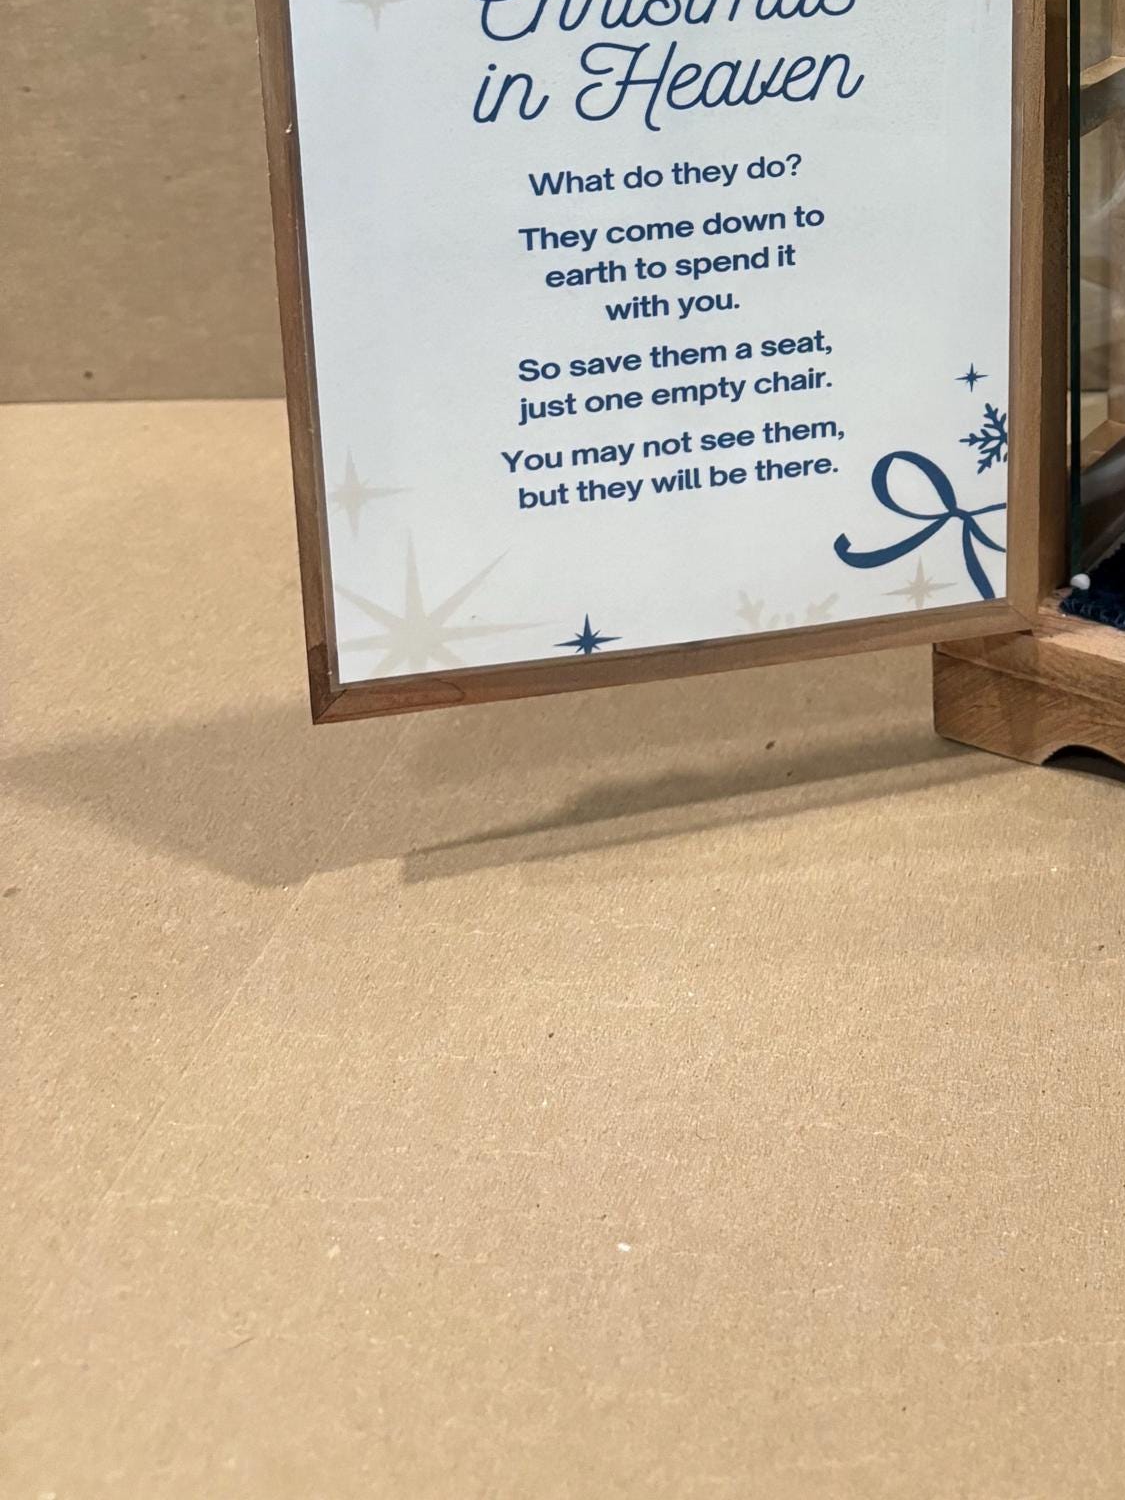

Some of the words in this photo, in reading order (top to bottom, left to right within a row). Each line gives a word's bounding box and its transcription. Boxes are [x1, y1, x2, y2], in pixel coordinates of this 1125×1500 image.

[472, 63, 550, 124] in
[575, 40, 865, 132] Heaven
[528, 167, 616, 197] What
[623, 165, 664, 190] do
[670, 161, 739, 188] they
[746, 153, 802, 180] do?
[517, 226, 599, 253] They
[605, 220, 695, 245] come
[702, 211, 786, 236] down
[793, 205, 825, 228] to
[545, 260, 627, 288] earth
[634, 257, 667, 280] to
[674, 246, 770, 281] spend
[777, 243, 796, 268] it
[604, 294, 670, 321] with
[677, 292, 740, 320] you.
[518, 358, 561, 382] So
[569, 353, 643, 377] save
[649, 344, 727, 369] them
[734, 342, 753, 360] a
[760, 329, 833, 357] seat,
[518, 392, 578, 426] just
[584, 391, 644, 413] one
[651, 376, 747, 407] empty
[753, 367, 833, 395] chair.
[500, 449, 563, 473] You
[571, 442, 635, 467] may
[643, 431, 693, 458] not
[700, 429, 756, 452] see
[762, 420, 845, 444] them,
[518, 483, 570, 510] but
[575, 478, 644, 503] they
[650, 467, 703, 494] will
[709, 465, 748, 488] be
[754, 457, 839, 482] there.
